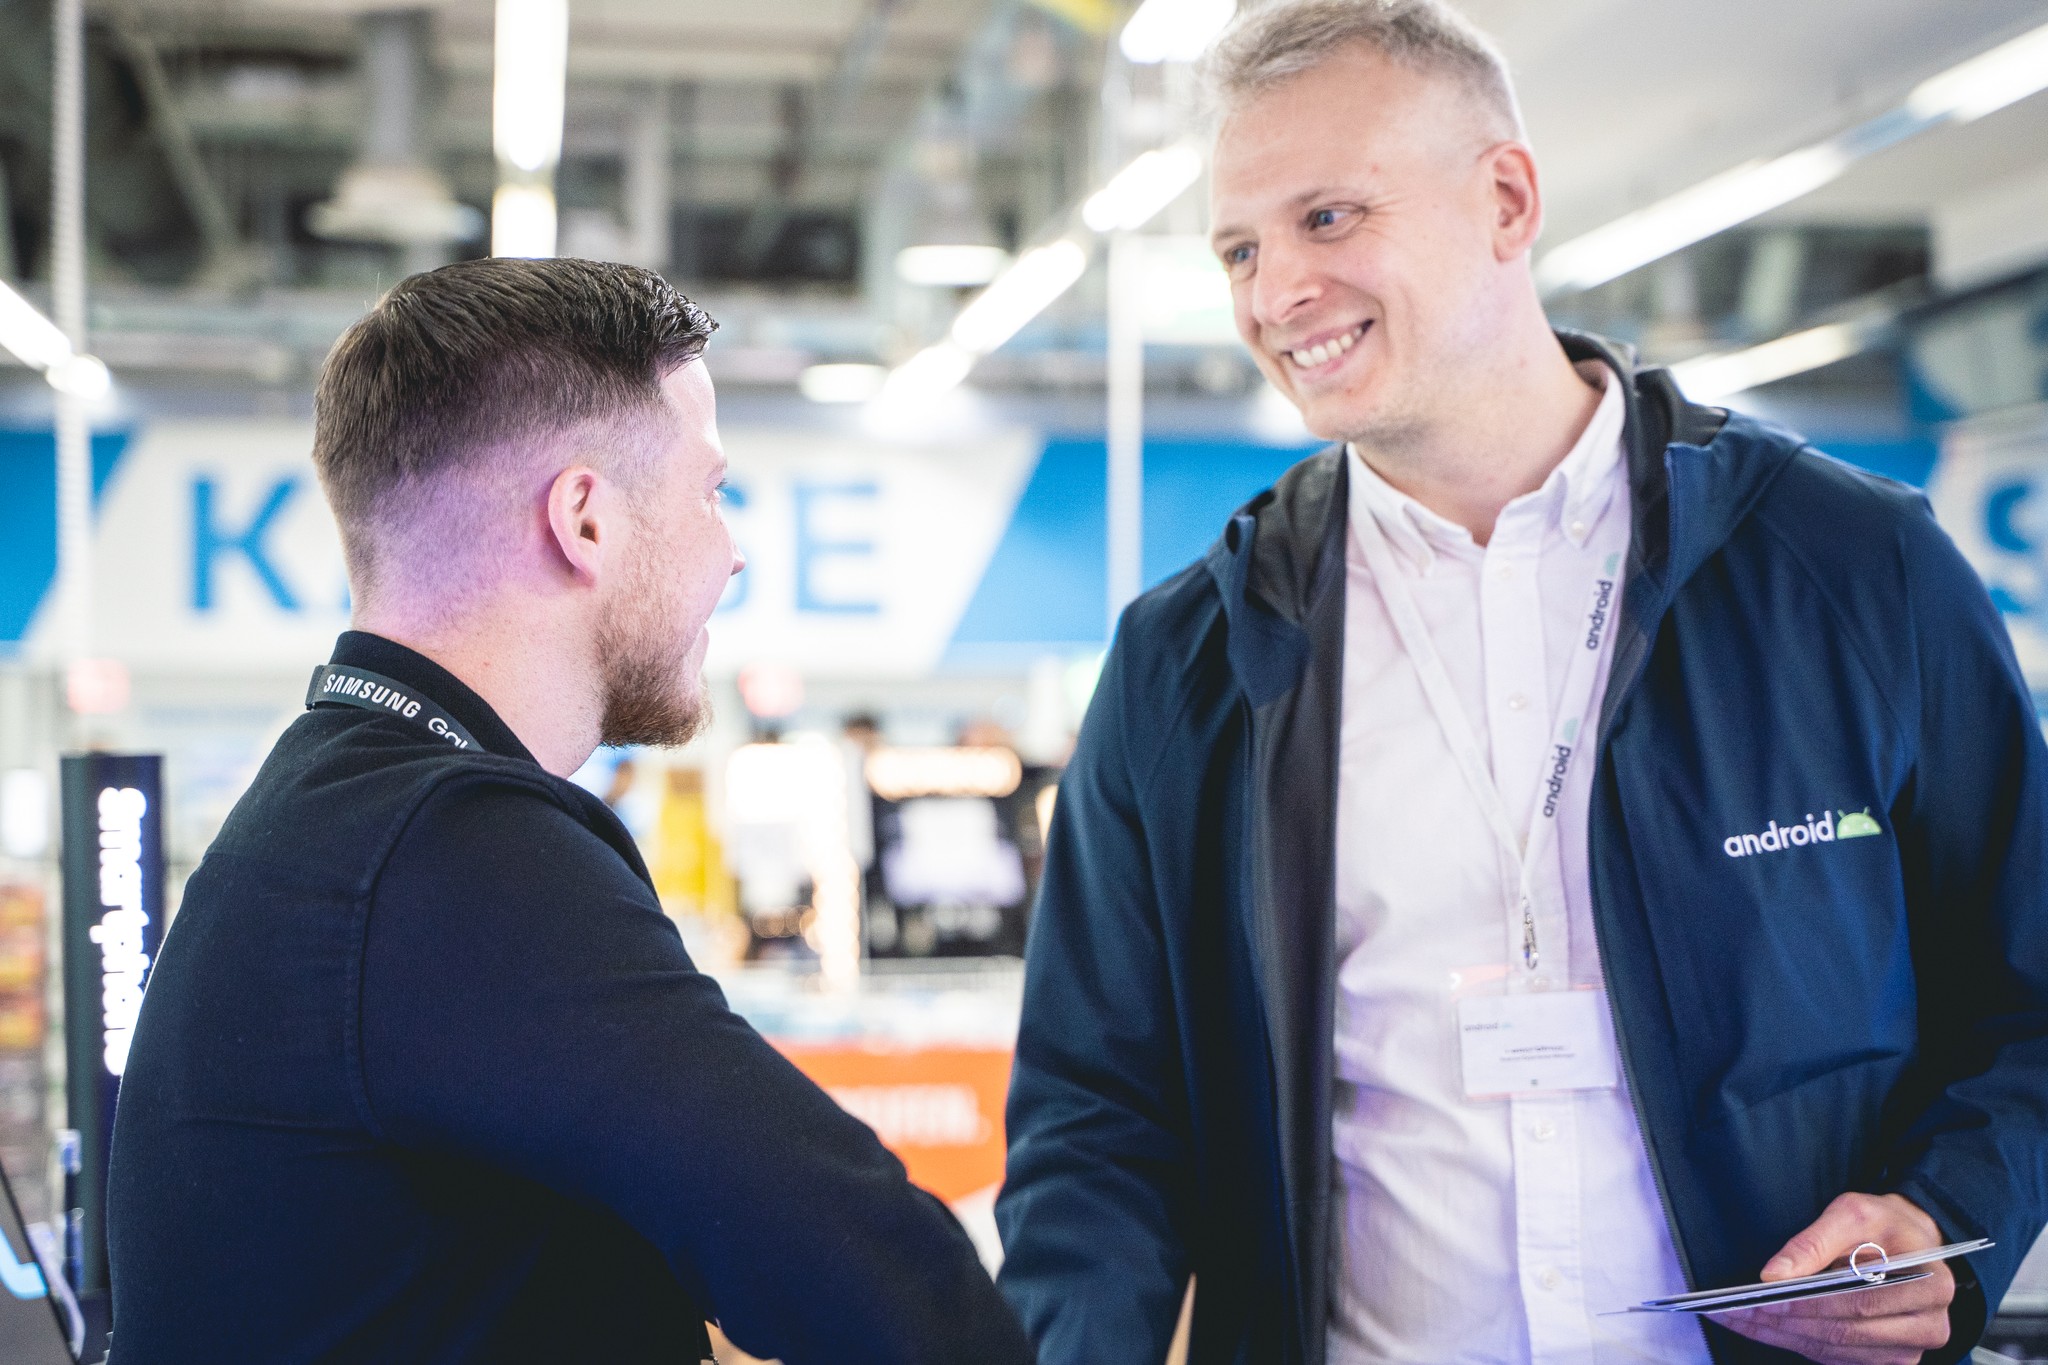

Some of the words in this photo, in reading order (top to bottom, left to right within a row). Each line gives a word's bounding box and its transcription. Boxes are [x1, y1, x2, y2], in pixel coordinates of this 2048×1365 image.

[1586, 579, 1613, 651] android
[323, 673, 421, 718] SAMSUNG
[1542, 744, 1571, 818] android
[1724, 810, 1835, 858] android
